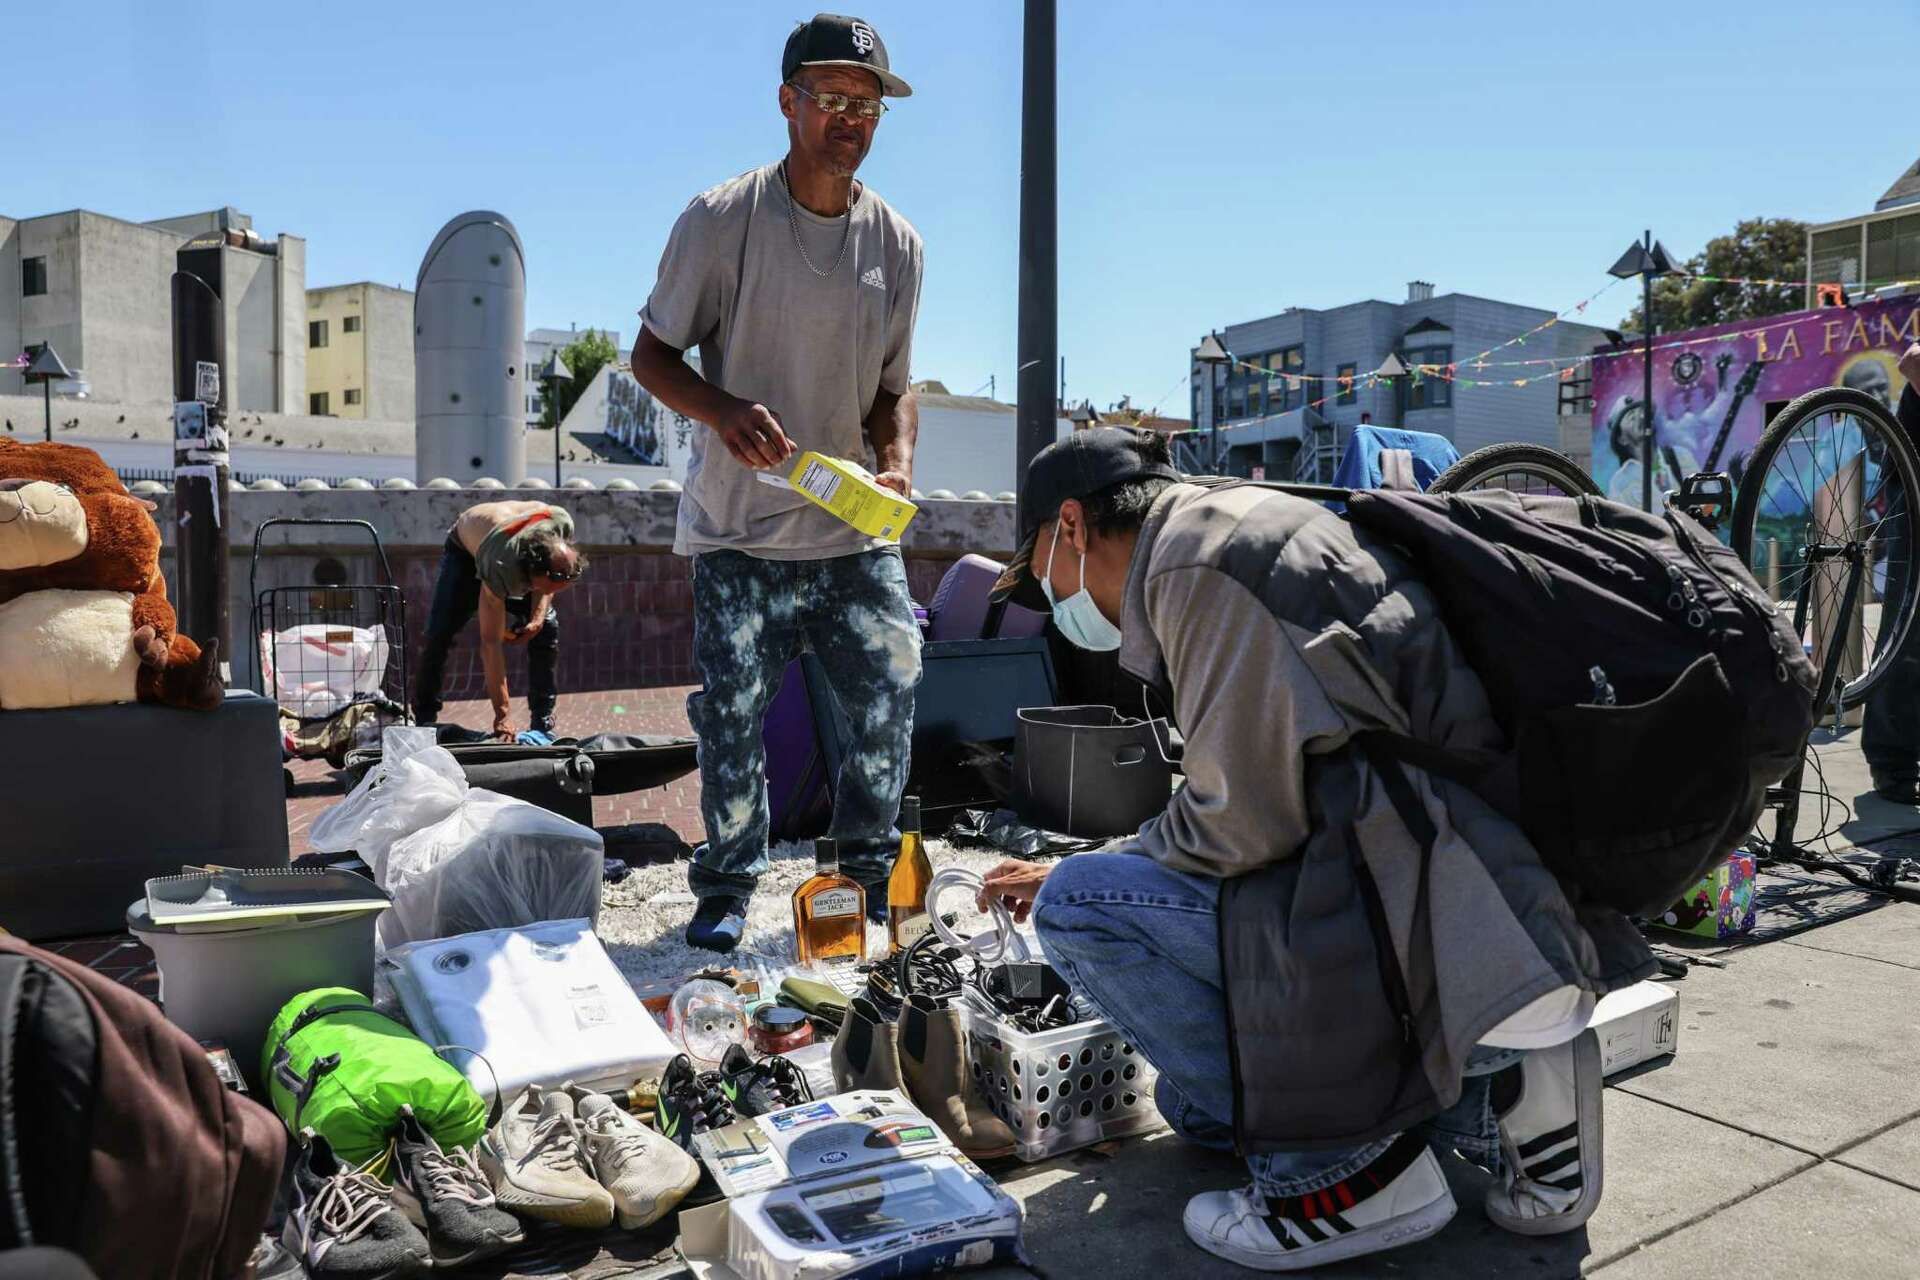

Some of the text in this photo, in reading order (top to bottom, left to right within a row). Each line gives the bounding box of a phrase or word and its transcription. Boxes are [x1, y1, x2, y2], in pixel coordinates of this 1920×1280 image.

[1756, 328, 1801, 362] LA
[814, 896, 856, 906] GENTLEMAN
[827, 903, 844, 911] JACK
